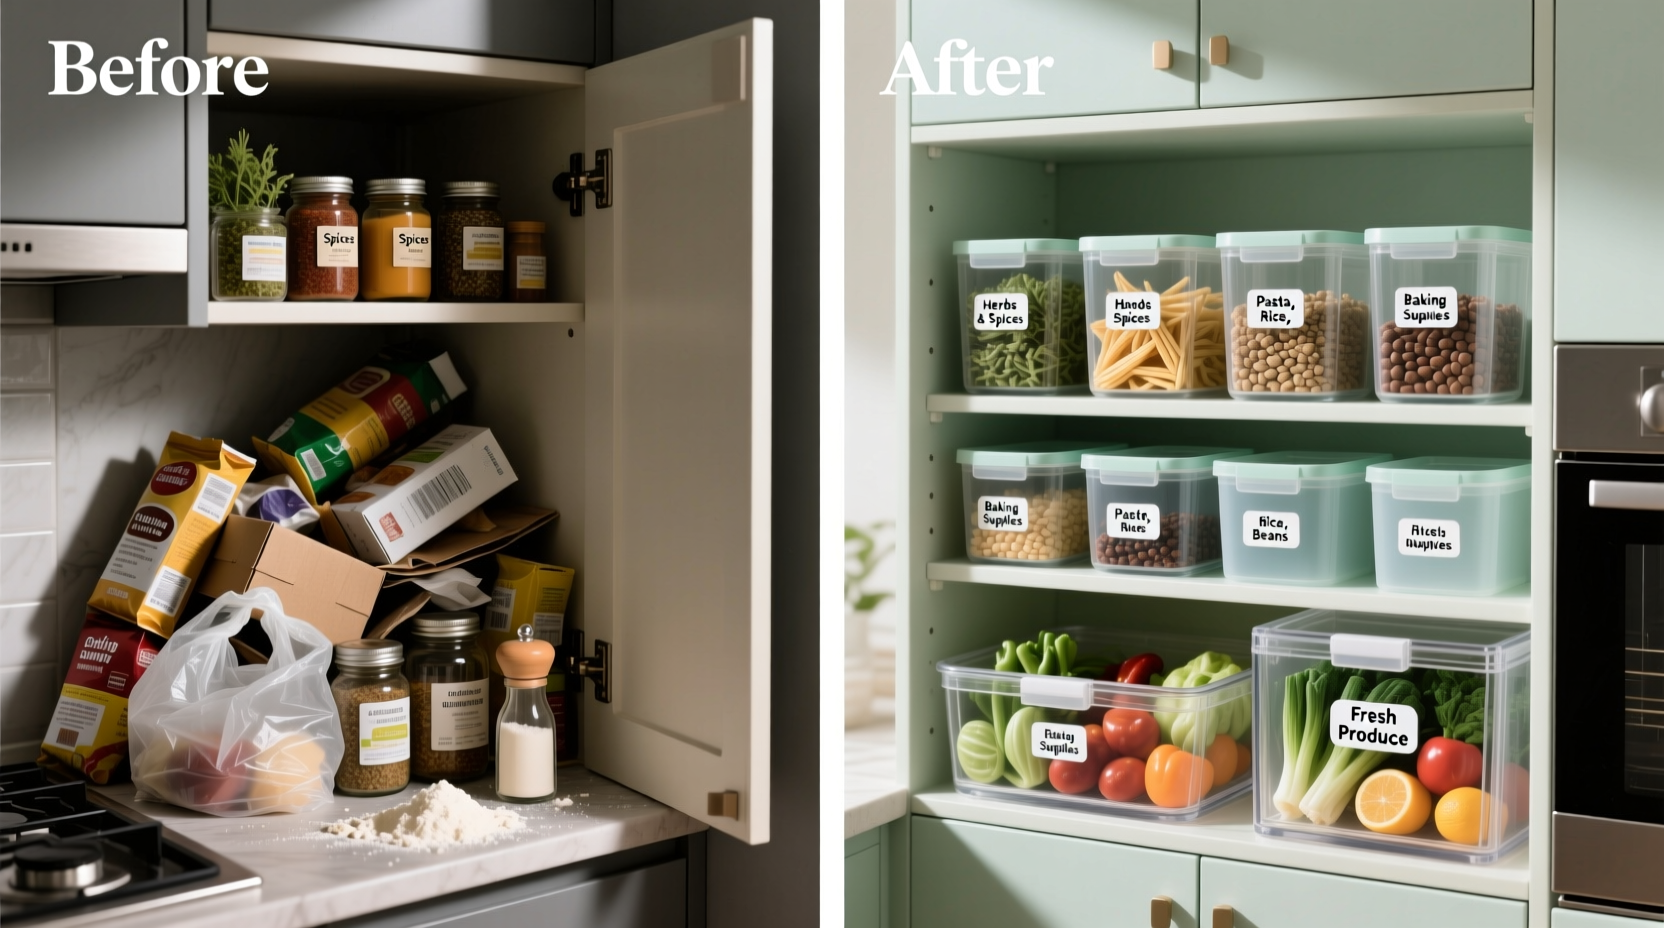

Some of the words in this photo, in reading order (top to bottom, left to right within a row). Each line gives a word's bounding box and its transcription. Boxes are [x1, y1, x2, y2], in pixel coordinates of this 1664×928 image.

[398, 233, 429, 247] Spices
[983, 298, 1017, 310] Herbs
[1256, 295, 1295, 310] Pasta,
[1404, 293, 1446, 309] Baking
[989, 313, 1024, 327] Spices
[1113, 312, 1151, 327] Spices
[1260, 310, 1291, 325] Rice,
[984, 500, 1019, 515] Baking
[1252, 529, 1289, 542] Beans
[1351, 706, 1396, 725] Fresh
[1338, 725, 1409, 746] Produce
